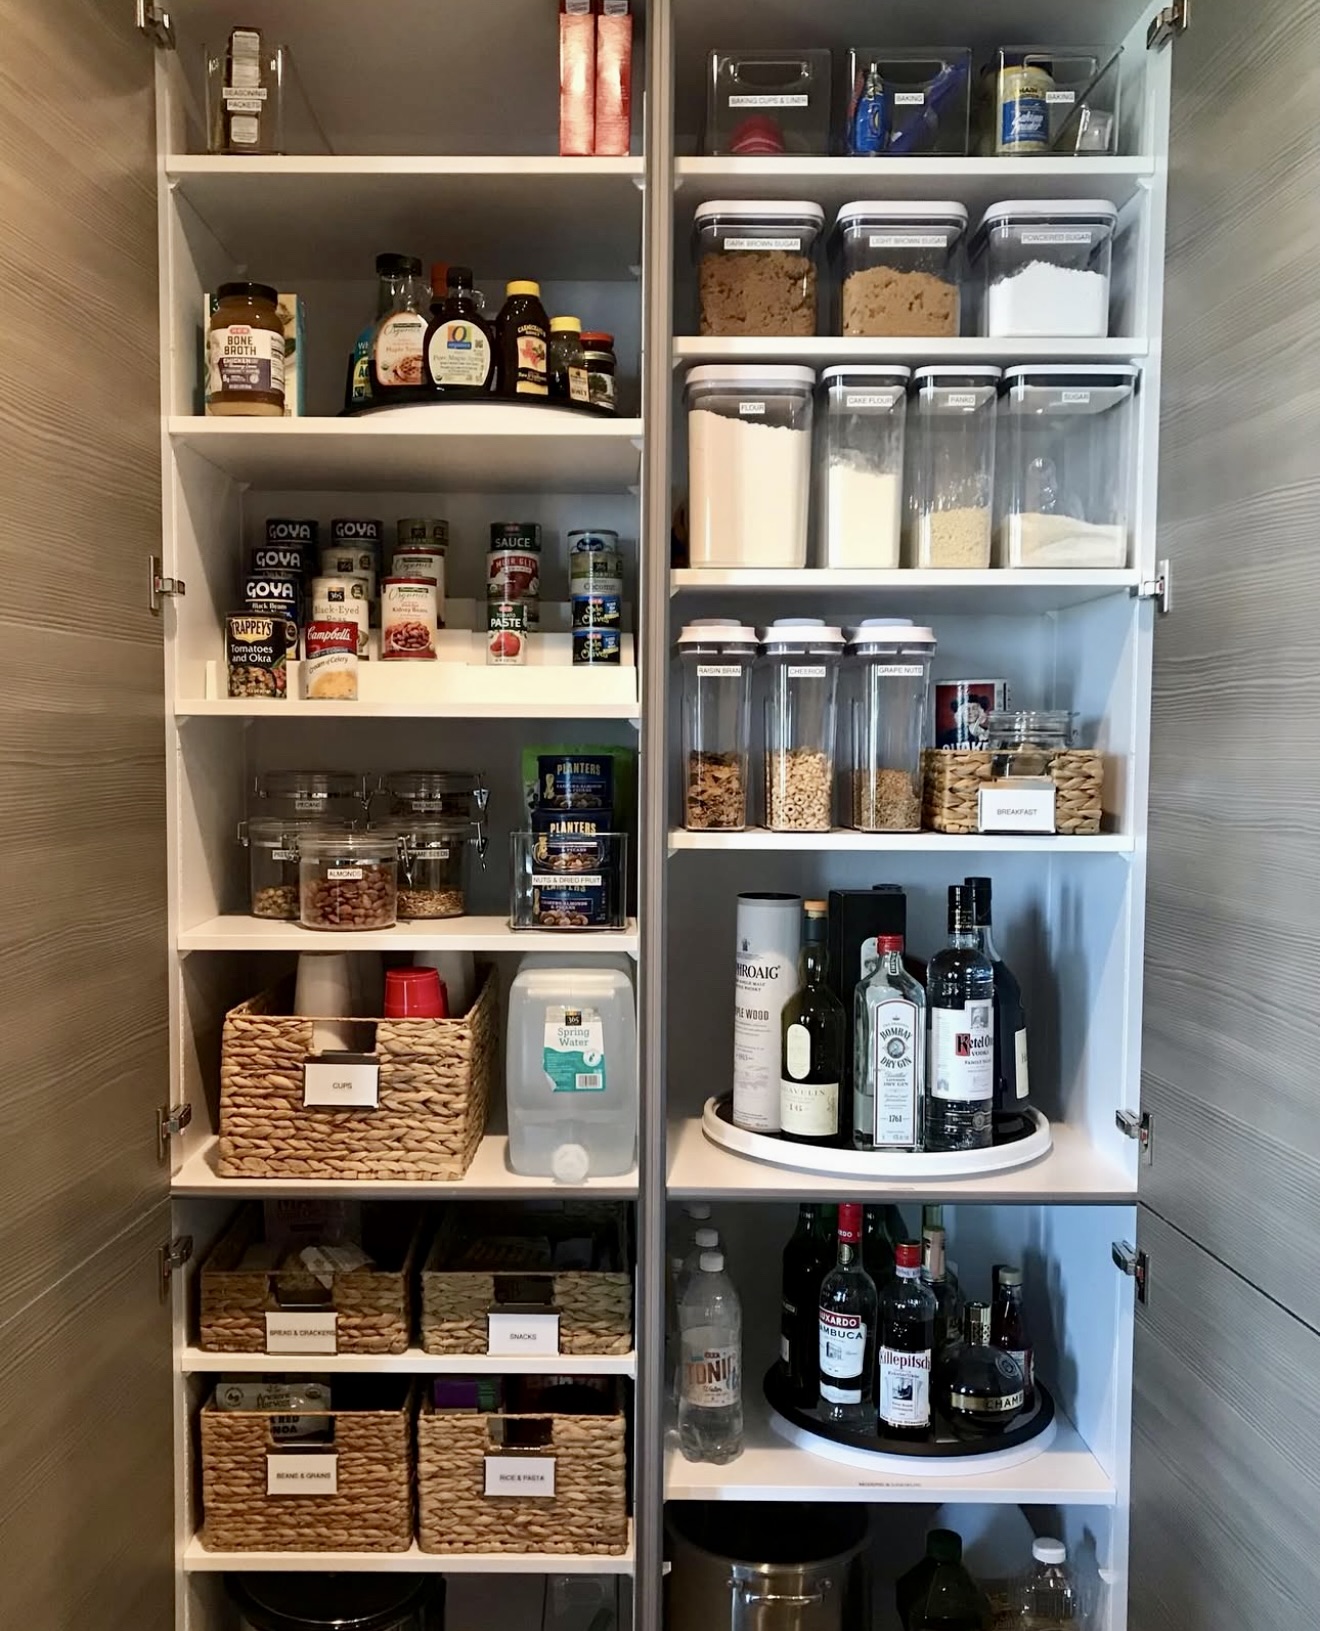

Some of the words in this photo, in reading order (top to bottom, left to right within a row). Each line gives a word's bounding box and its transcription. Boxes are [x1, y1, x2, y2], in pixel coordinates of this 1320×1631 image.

[228, 336, 252, 345] BONE
[224, 346, 257, 355] BROTH
[269, 524, 310, 538] GOYA
[336, 523, 376, 537] GOYA
[496, 538, 531, 548] SAUCE
[256, 552, 301, 567] GOYA
[246, 582, 293, 598] GOYA
[490, 618, 521, 628] PASTE
[231, 620, 272, 637] TRAPPEY'S
[307, 627, 351, 644] Campbell's
[231, 645, 273, 656] Tomatoes
[232, 655, 247, 663] and
[249, 654, 272, 663] Okra
[331, 656, 350, 665] Celery
[557, 763, 601, 775] PLANTERS
[550, 822, 597, 836] PLANTERS
[329, 868, 362, 877] ALMONDS
[569, 1016, 579, 1024] 365
[746, 1010, 769, 1020] WOOD
[558, 1028, 590, 1038] Spring
[880, 1028, 913, 1041] BOMBAY
[559, 1038, 589, 1047] Water
[956, 1034, 985, 1056] Ketel
[880, 1057, 896, 1069] DRY
[897, 1057, 912, 1069] GIN
[889, 1115, 902, 1123] 1761
